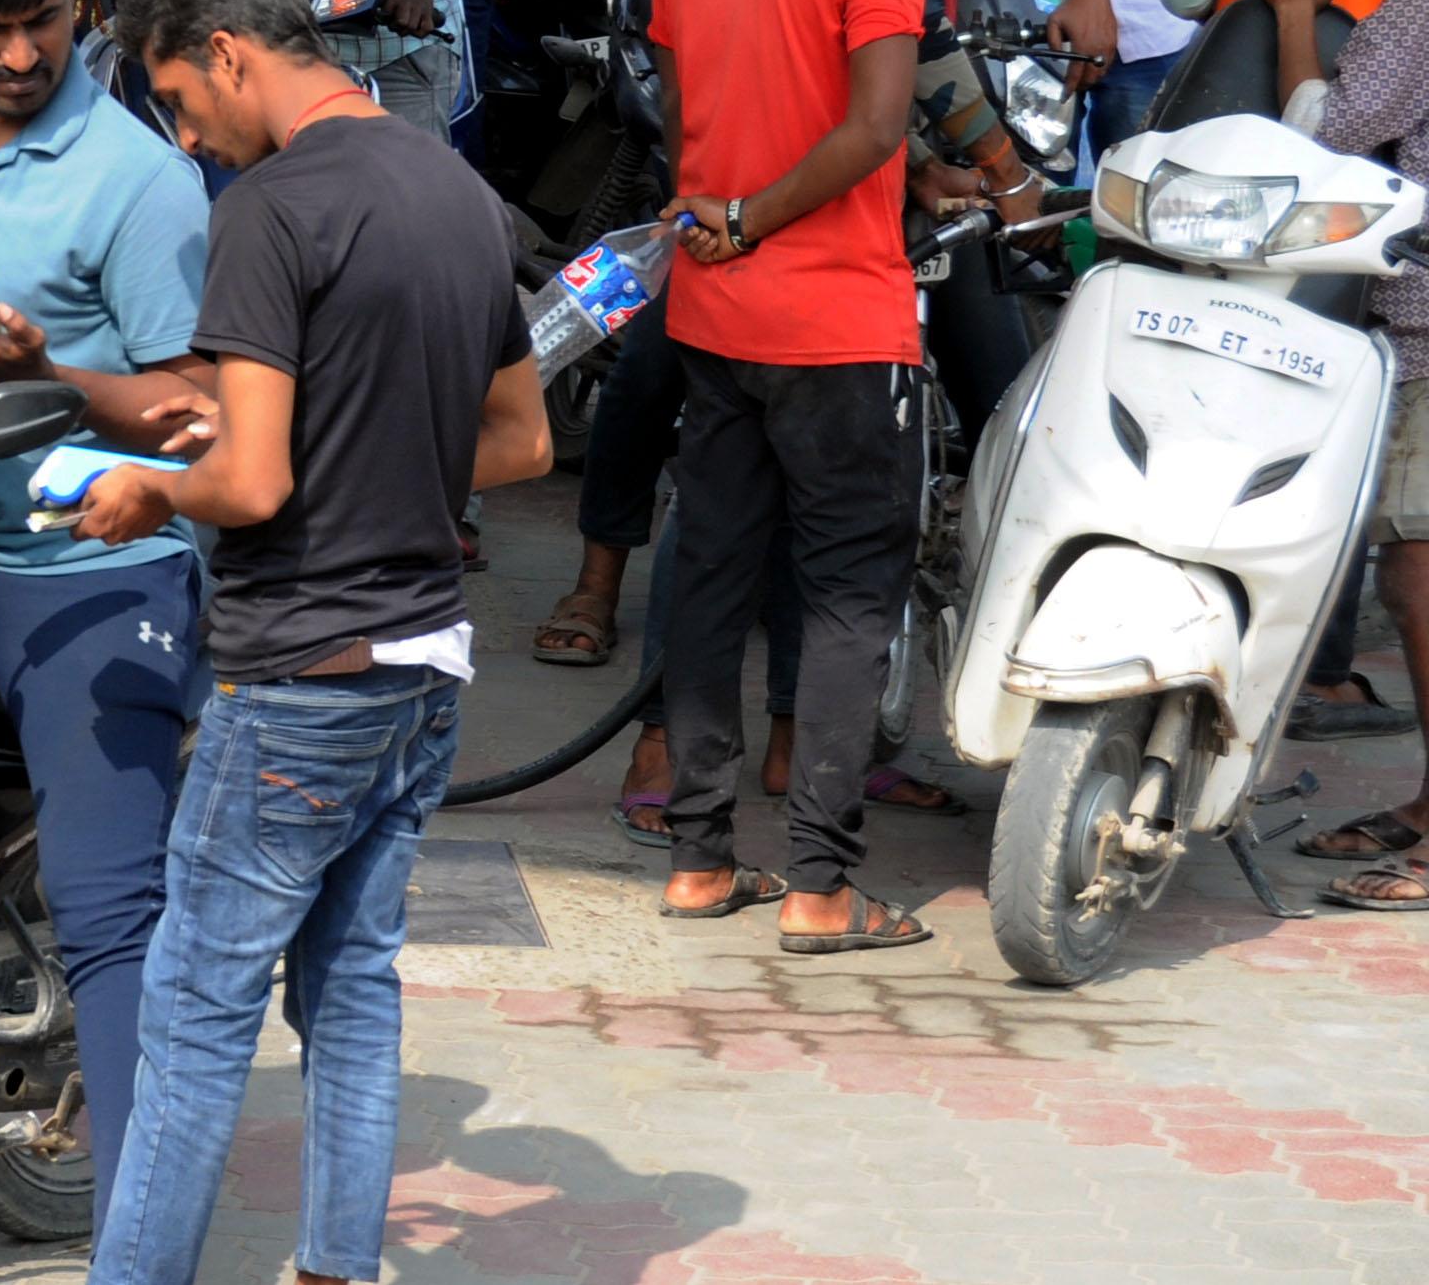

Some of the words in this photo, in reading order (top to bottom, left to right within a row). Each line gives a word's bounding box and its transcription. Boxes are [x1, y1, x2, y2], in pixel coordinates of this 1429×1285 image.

[1208, 298, 1282, 327] HONDA
[1136, 310, 1162, 331] TS
[1220, 330, 1248, 355] ET
